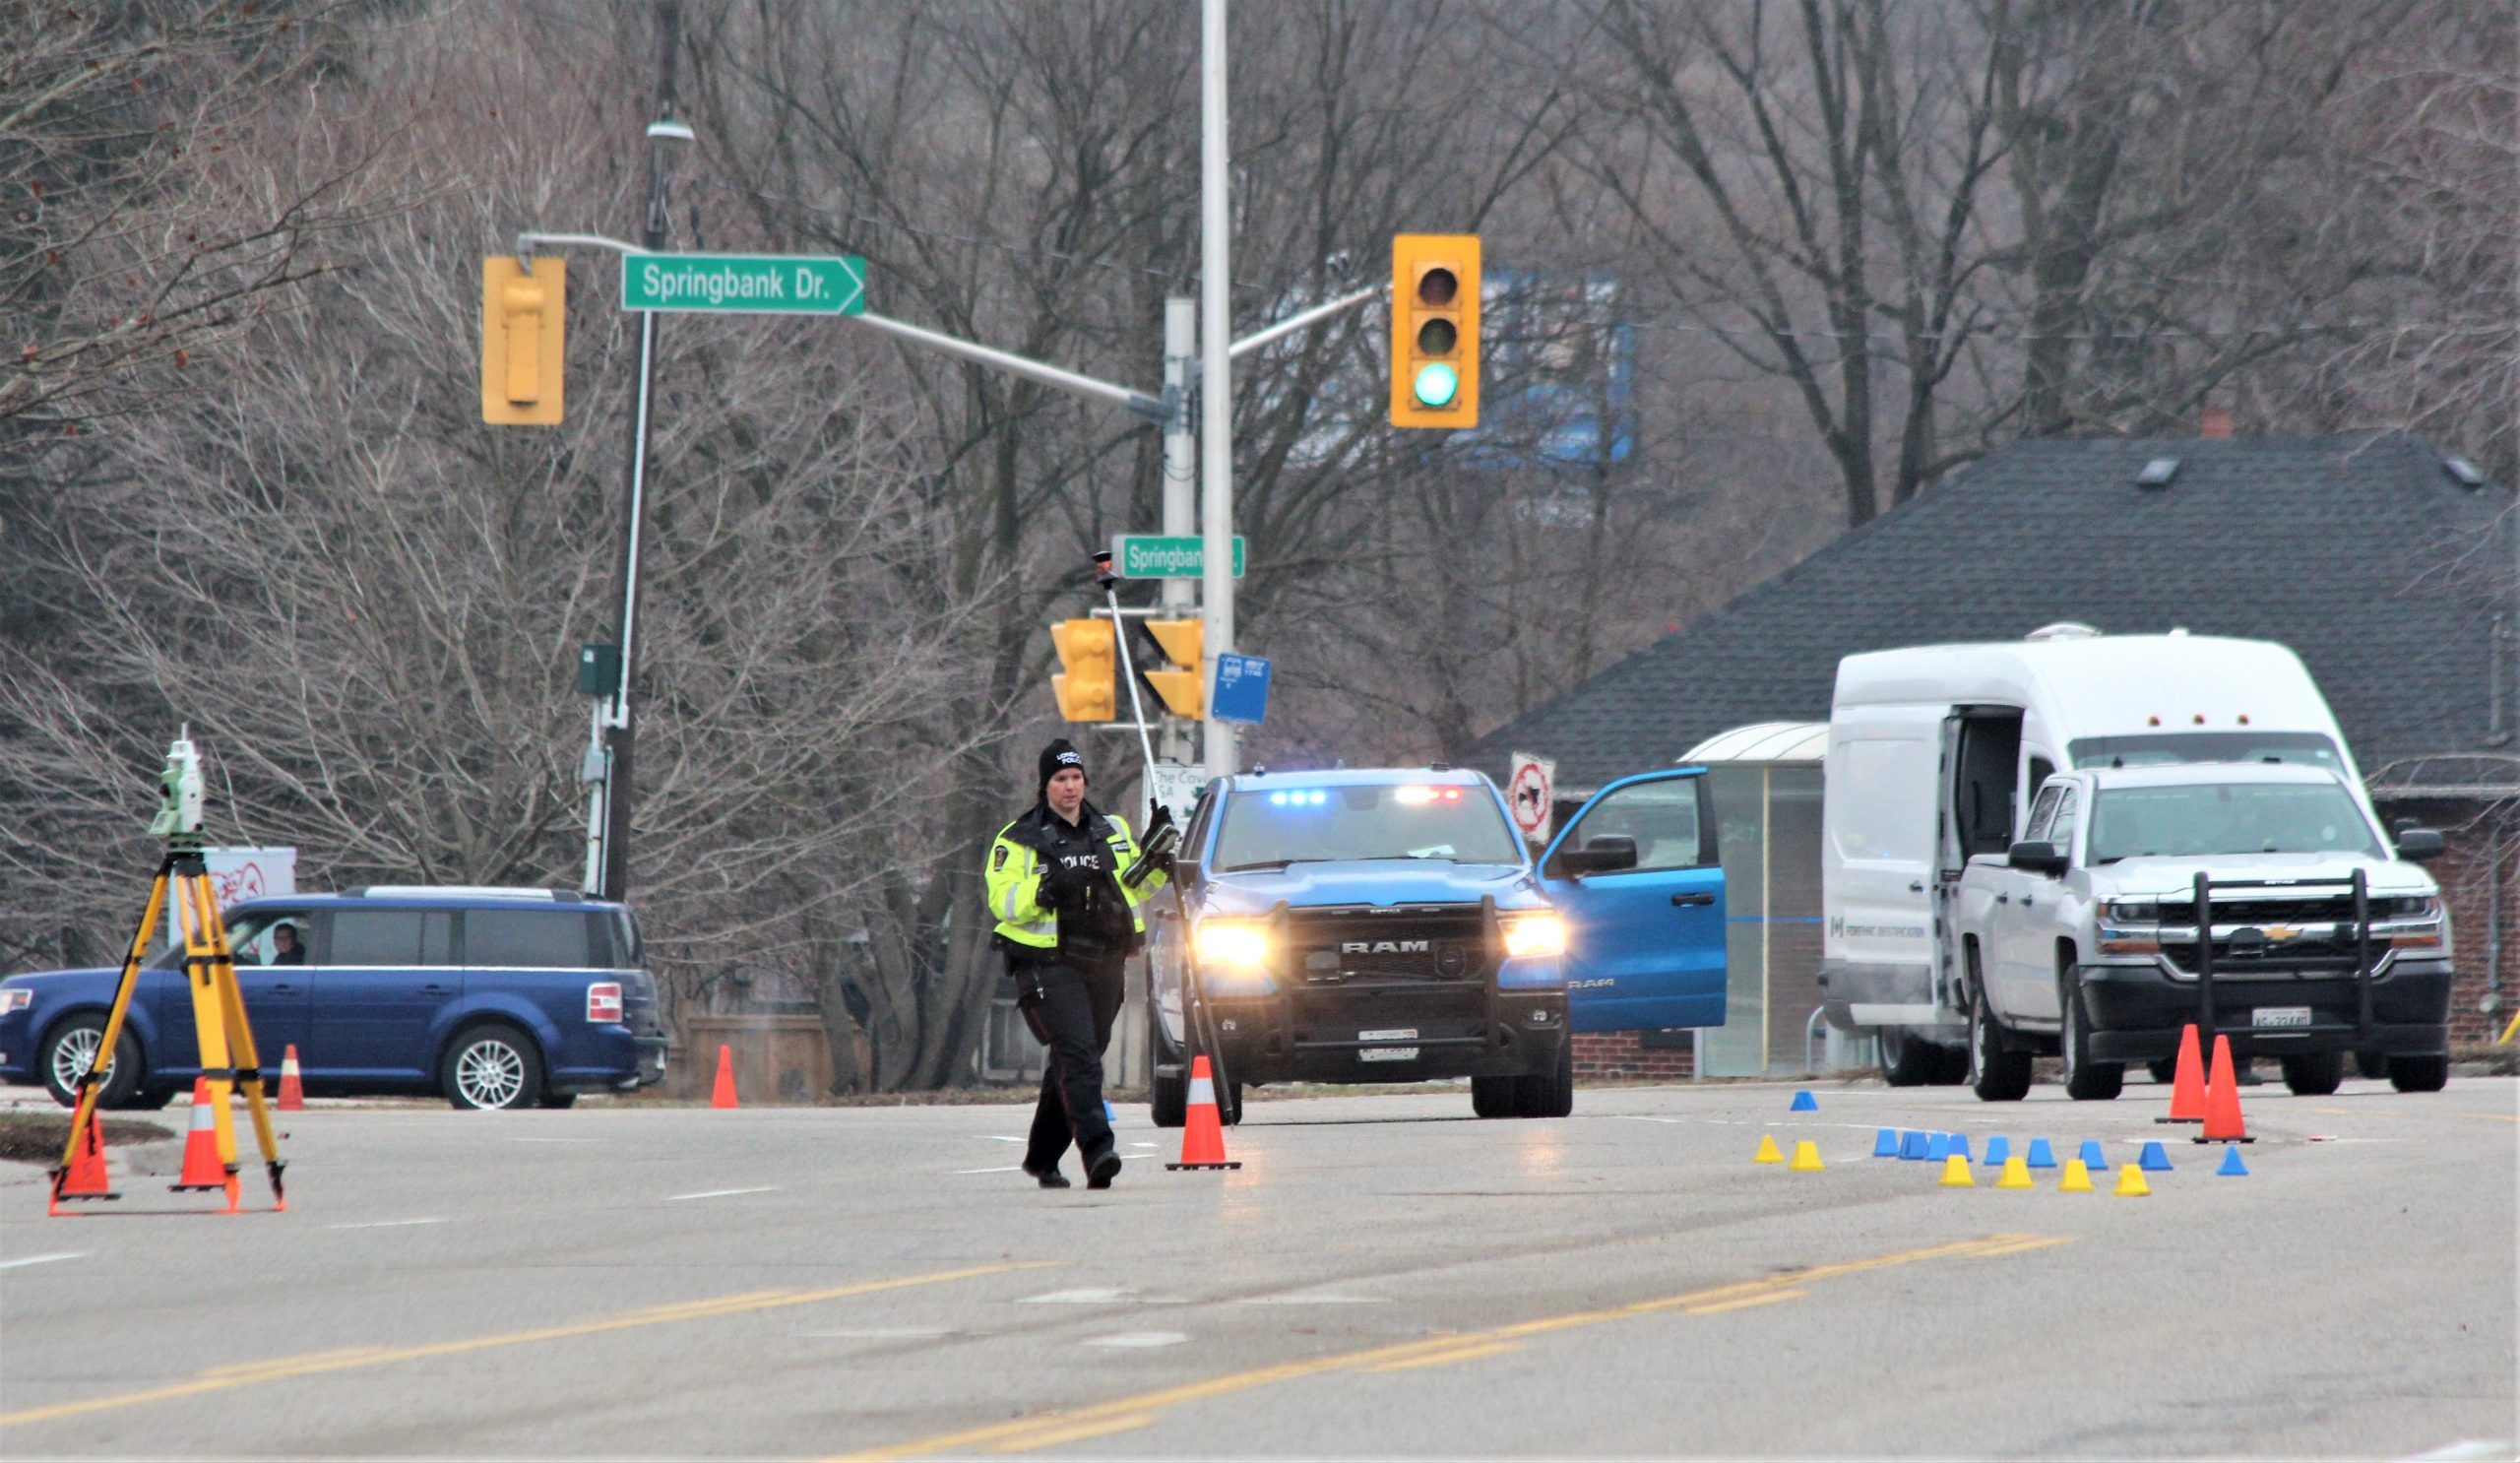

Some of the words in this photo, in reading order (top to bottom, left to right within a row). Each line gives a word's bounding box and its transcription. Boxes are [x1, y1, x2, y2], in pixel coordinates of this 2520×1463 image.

[643, 264, 784, 304] Springbank
[795, 268, 829, 299] Dr.
[1129, 544, 1204, 572] Springban
[1342, 940, 1428, 954] RAM
